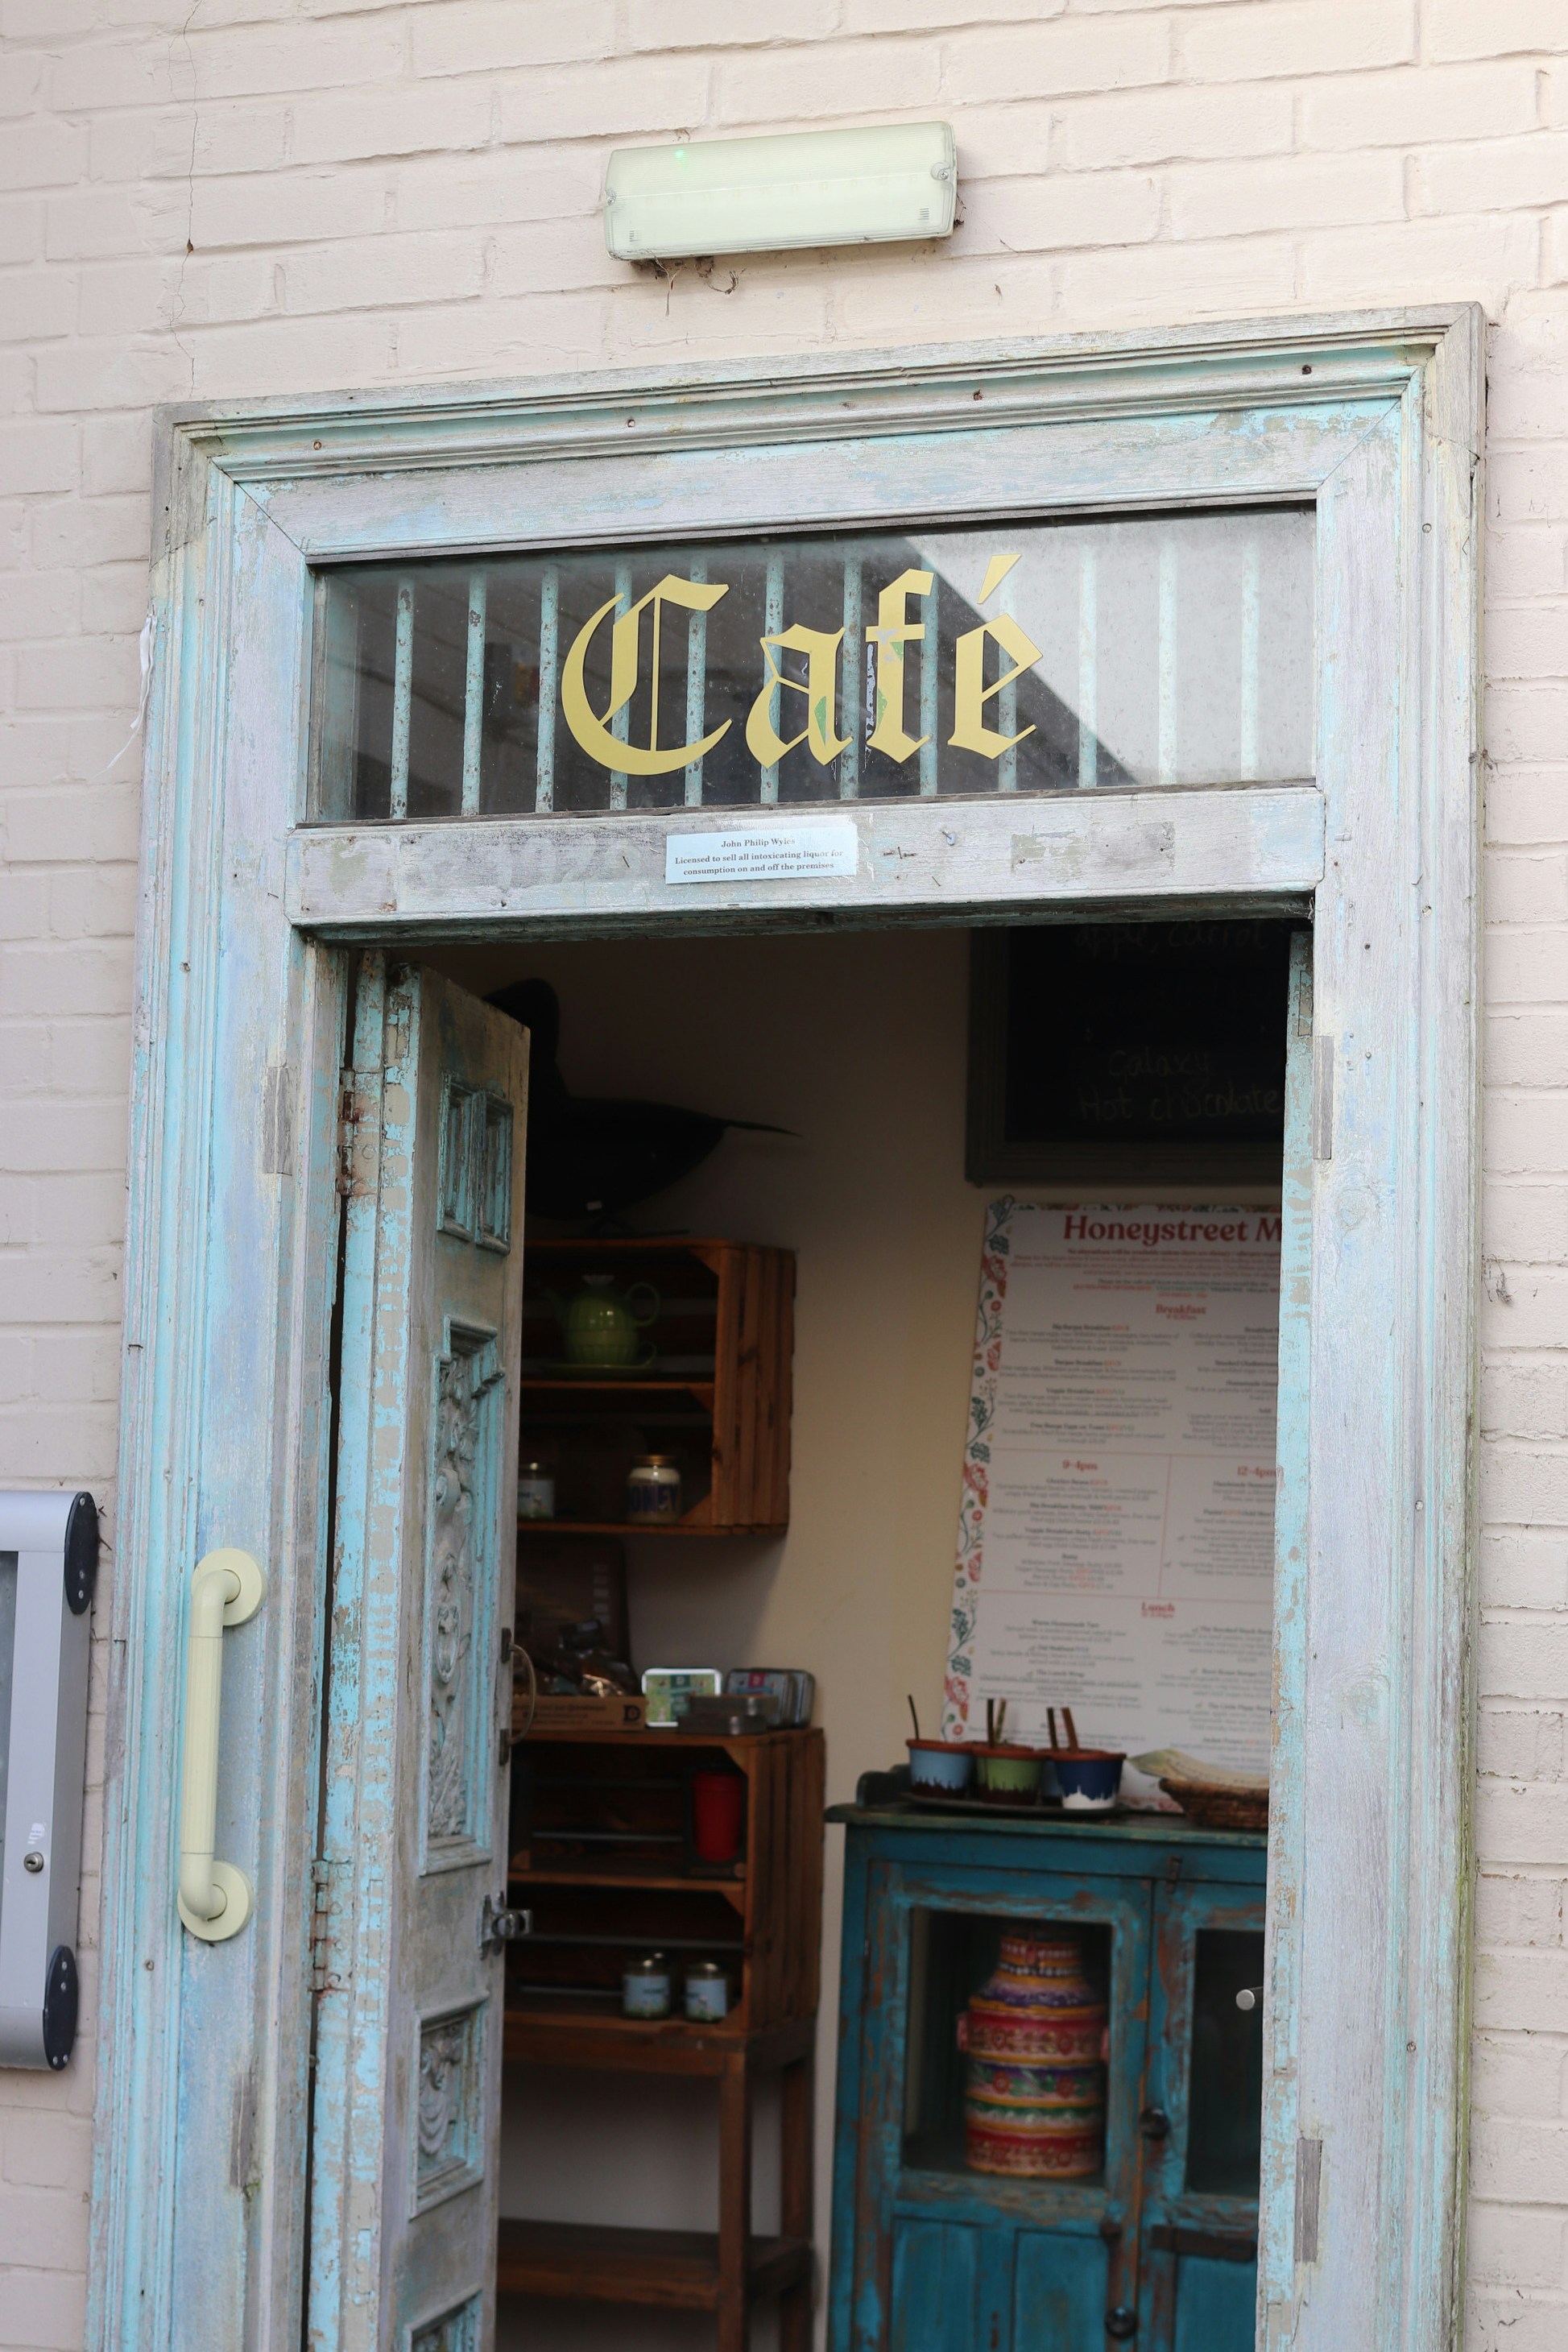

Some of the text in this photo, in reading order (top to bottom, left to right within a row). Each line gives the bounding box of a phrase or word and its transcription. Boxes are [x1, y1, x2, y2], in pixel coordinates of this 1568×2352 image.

[561, 553, 1044, 776] Café
[722, 838, 796, 848] John Philip Wyles
[675, 855, 710, 864] Licensed
[722, 854, 737, 862] sell
[751, 851, 801, 860] intoxicating
[803, 850, 829, 858] liquor
[831, 849, 843, 857] for
[683, 866, 735, 876] consumption
[767, 863, 780, 871] off
[780, 863, 794, 871] the
[796, 861, 834, 872] premises
[1064, 1215, 1249, 1247] Honeystreet
[1156, 1303, 1206, 1315] Breakfast
[628, 1483, 679, 1513] ONEY
